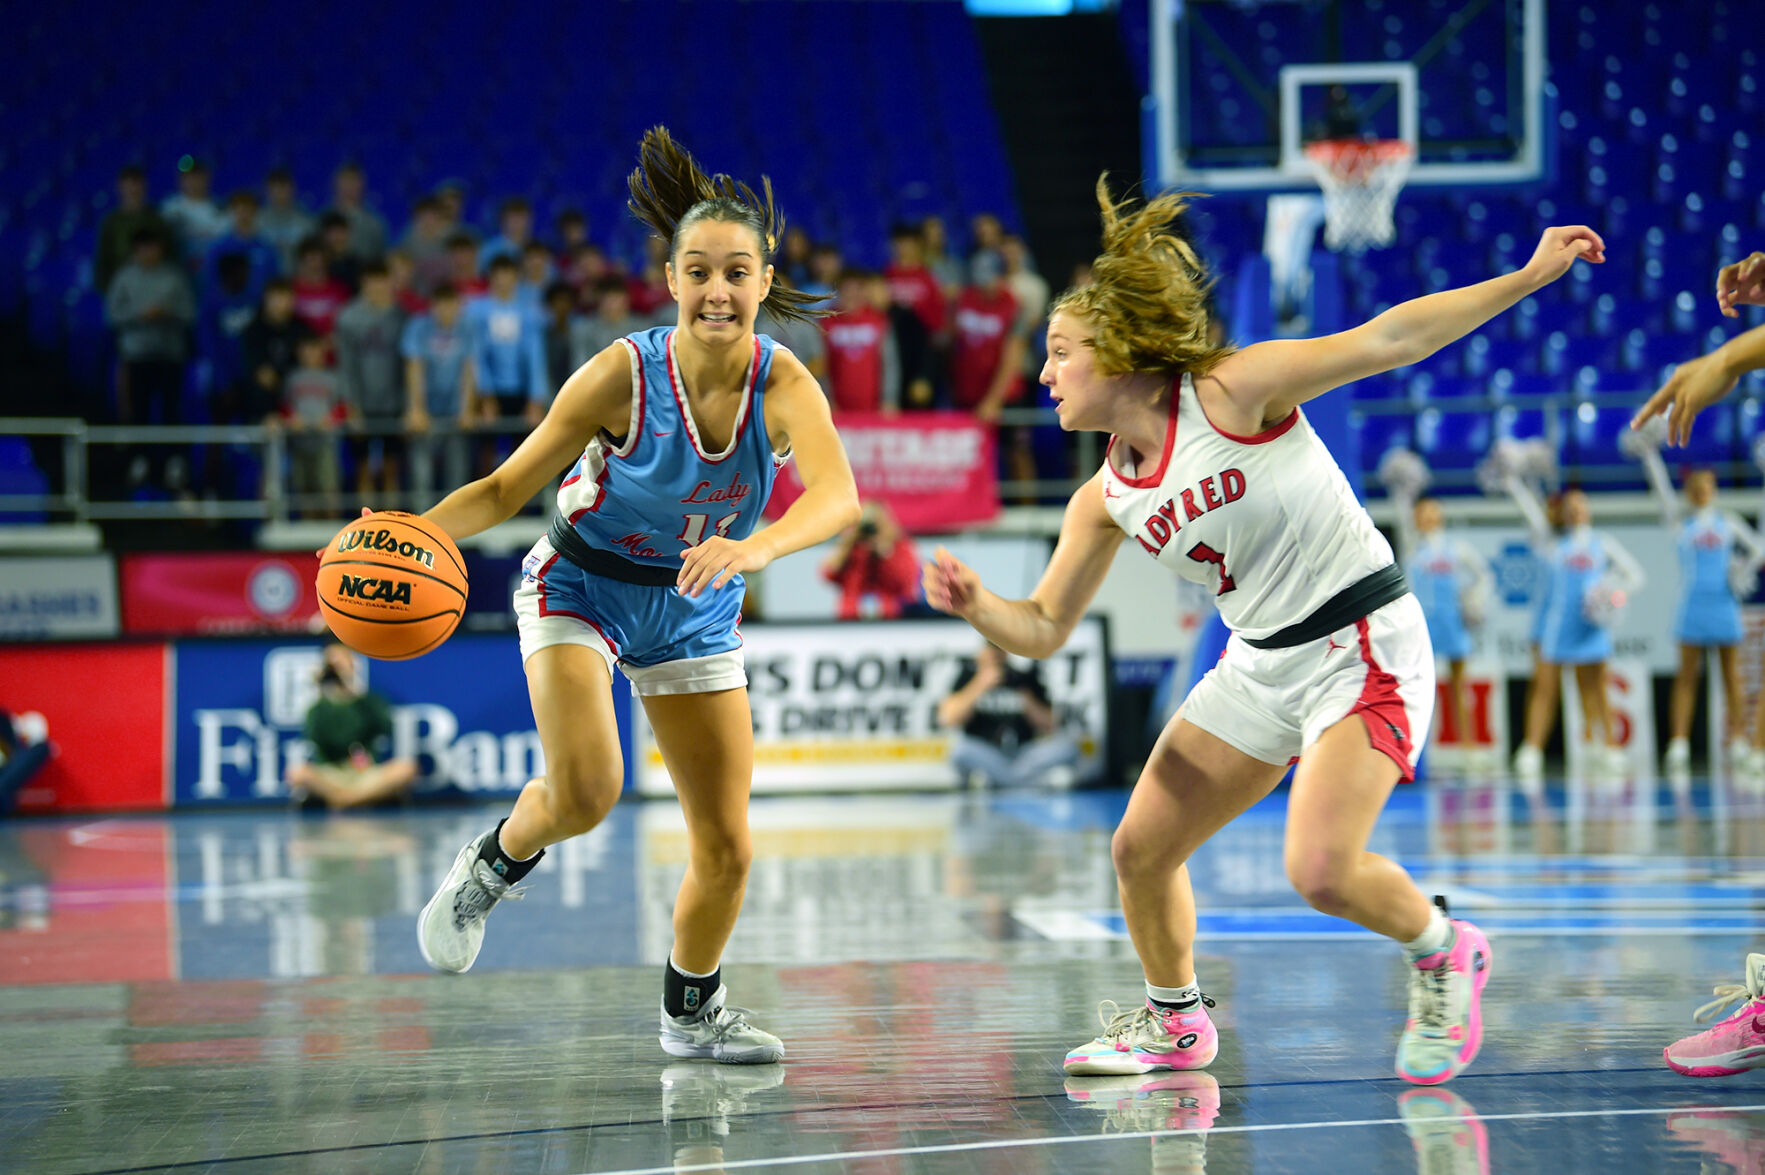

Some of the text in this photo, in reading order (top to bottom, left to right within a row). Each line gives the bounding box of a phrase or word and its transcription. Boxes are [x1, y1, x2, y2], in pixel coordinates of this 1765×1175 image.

[680, 472, 752, 507] Lady
[337, 529, 435, 571] Wilson
[338, 573, 411, 605] NCAA
[781, 705, 907, 733] DRIVE
